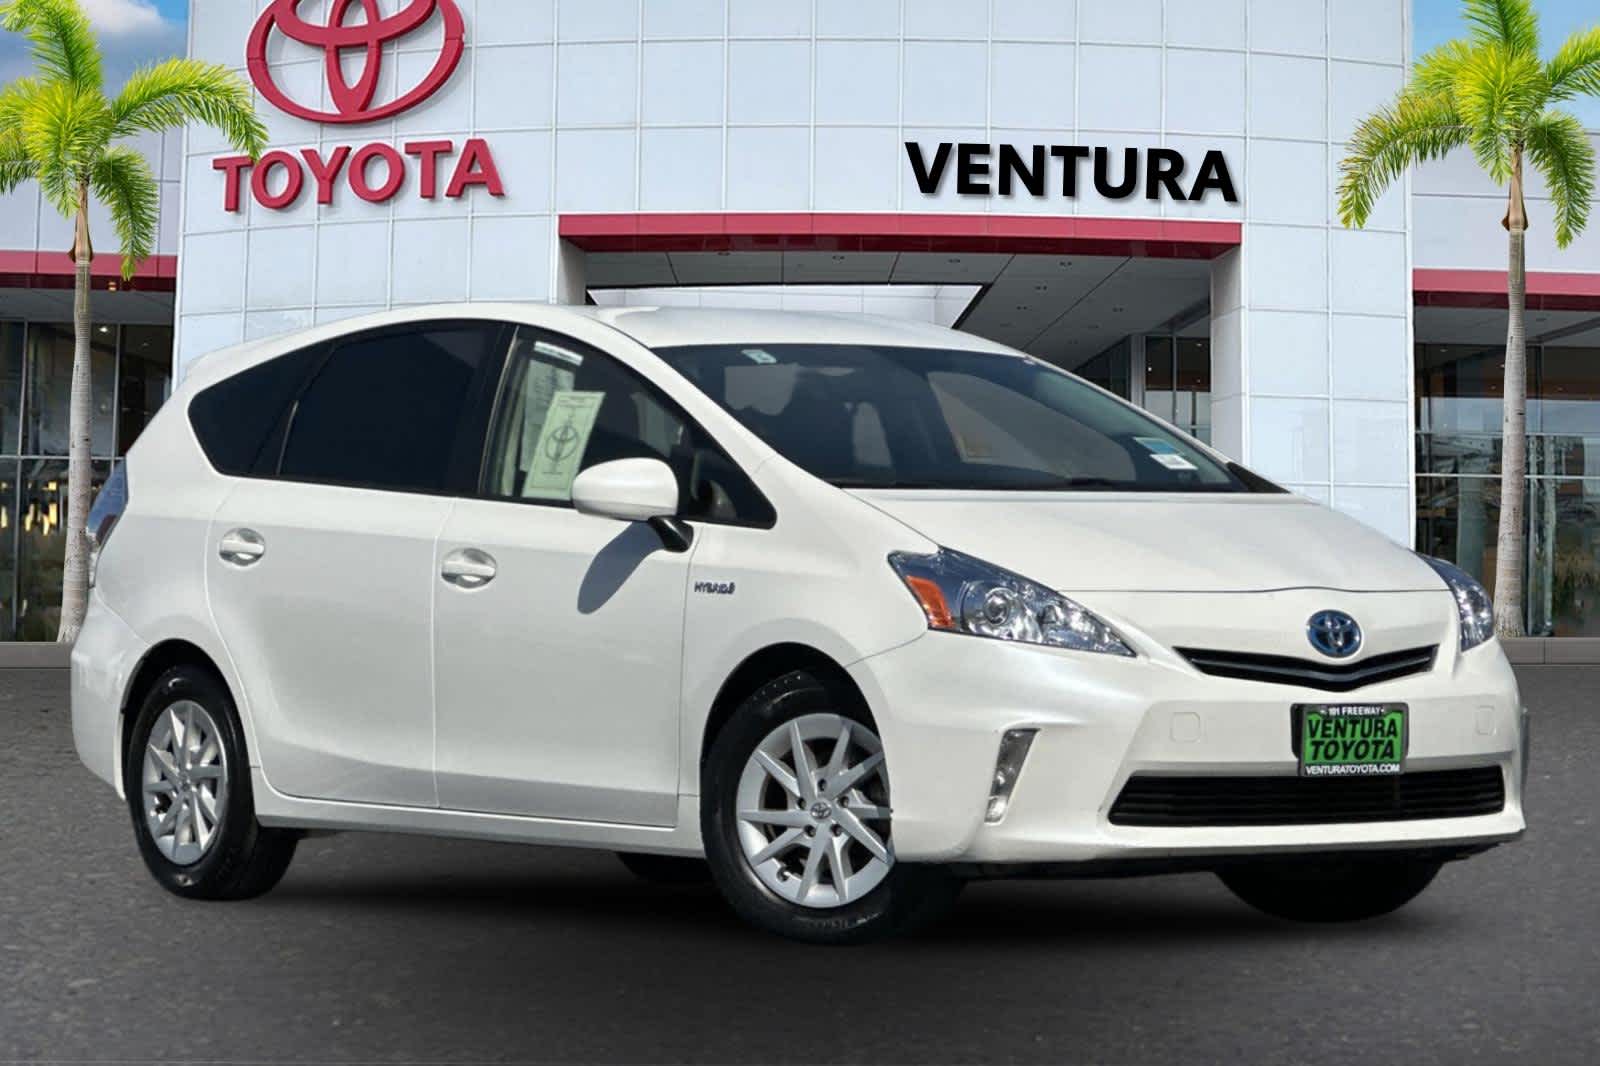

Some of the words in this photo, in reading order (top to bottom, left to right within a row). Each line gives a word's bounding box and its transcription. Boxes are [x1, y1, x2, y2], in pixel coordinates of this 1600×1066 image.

[213, 139, 505, 212] TOYOTA
[905, 142, 1238, 202] VENTURA
[1342, 706, 1380, 716] FREEWAY
[1308, 718, 1398, 738] VENTURA
[1311, 740, 1395, 760] TOYOTA
[1305, 764, 1400, 775] VENTURATOYOTA.COM
